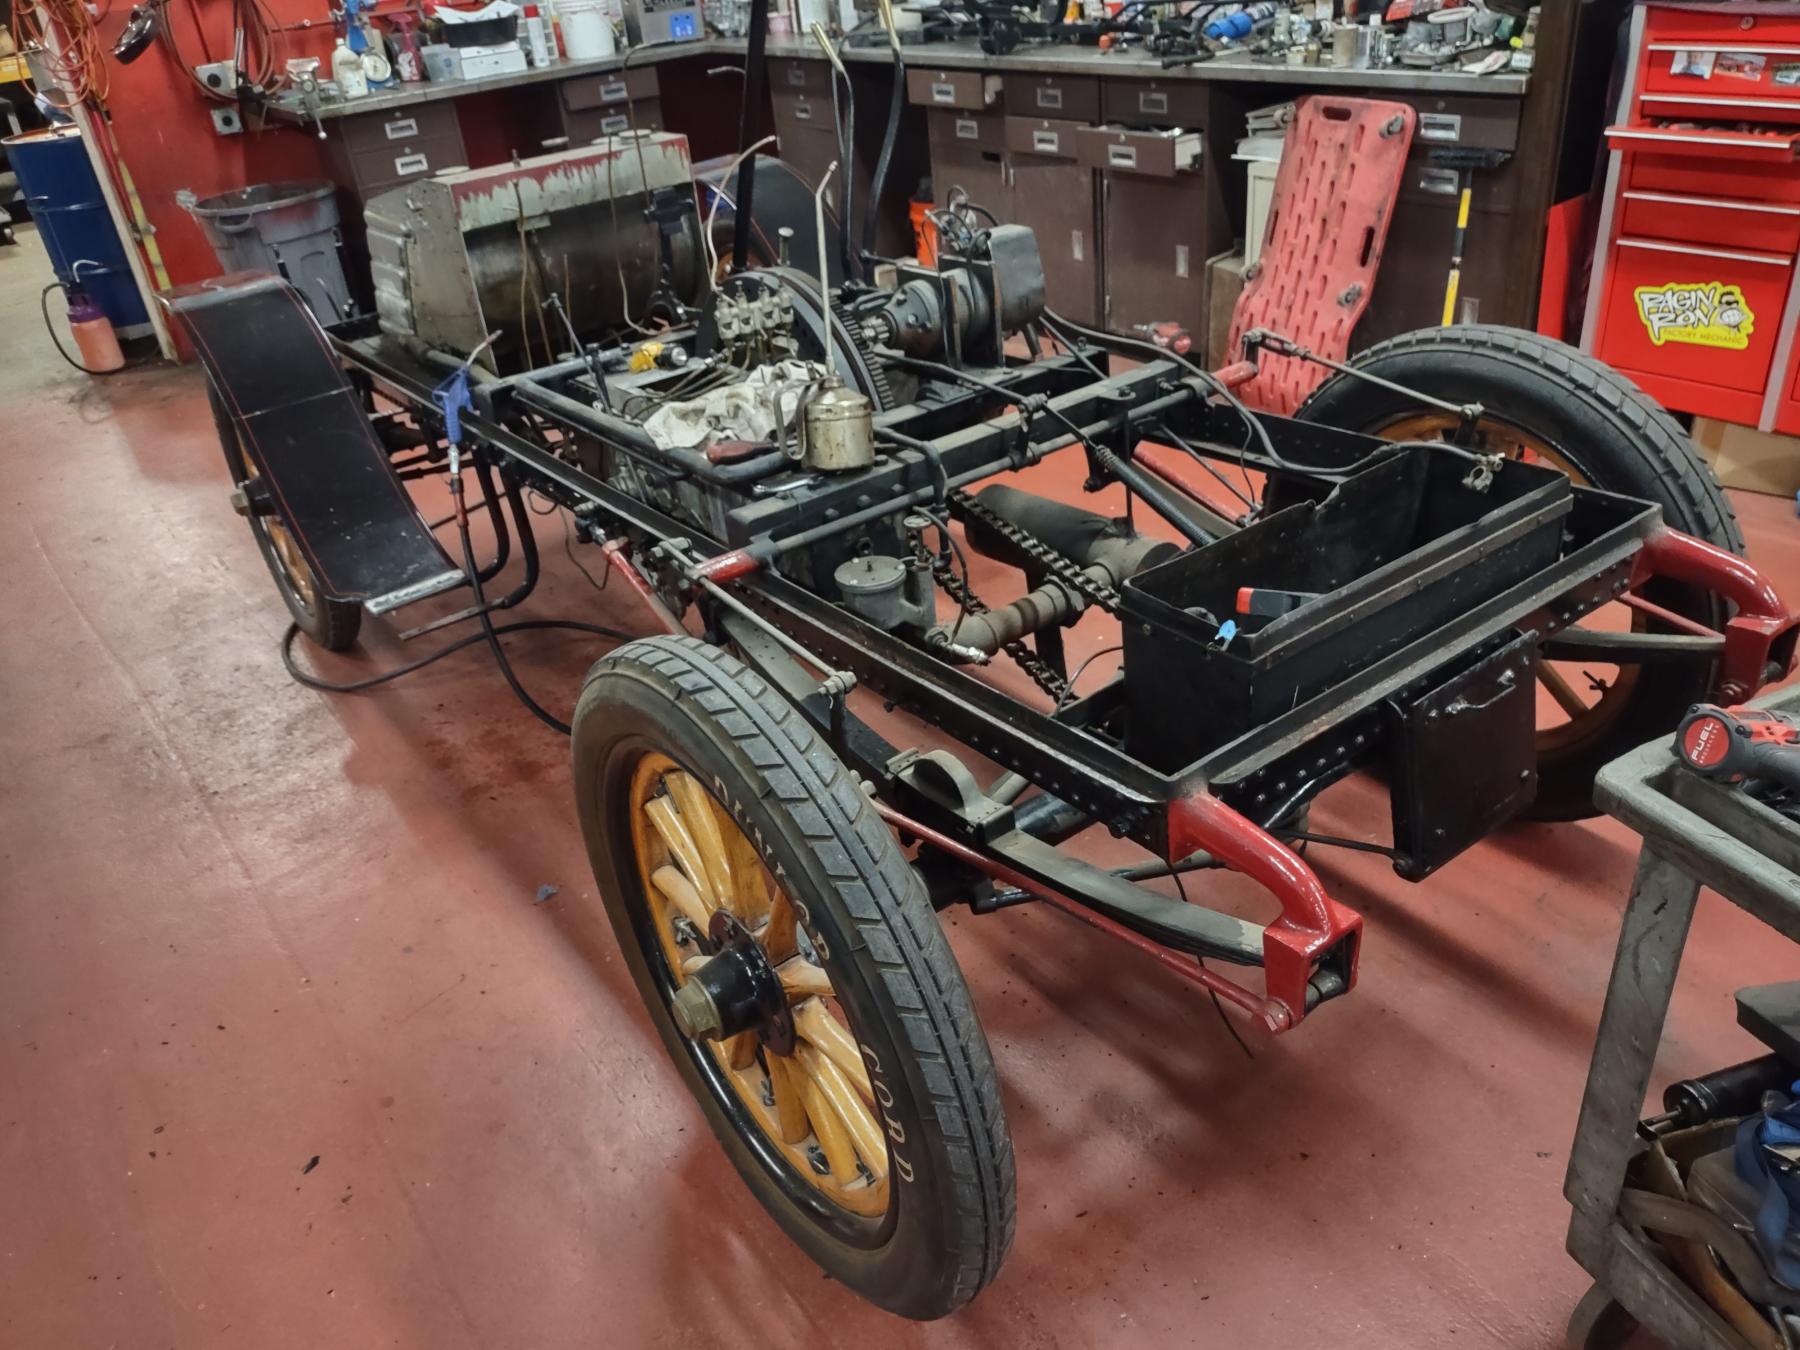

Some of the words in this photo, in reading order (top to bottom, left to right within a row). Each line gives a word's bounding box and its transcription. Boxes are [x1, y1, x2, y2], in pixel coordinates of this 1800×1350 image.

[1648, 307, 1717, 341] RON
[1690, 722, 1714, 761] FUEL
[860, 1043, 915, 1183] CORD
